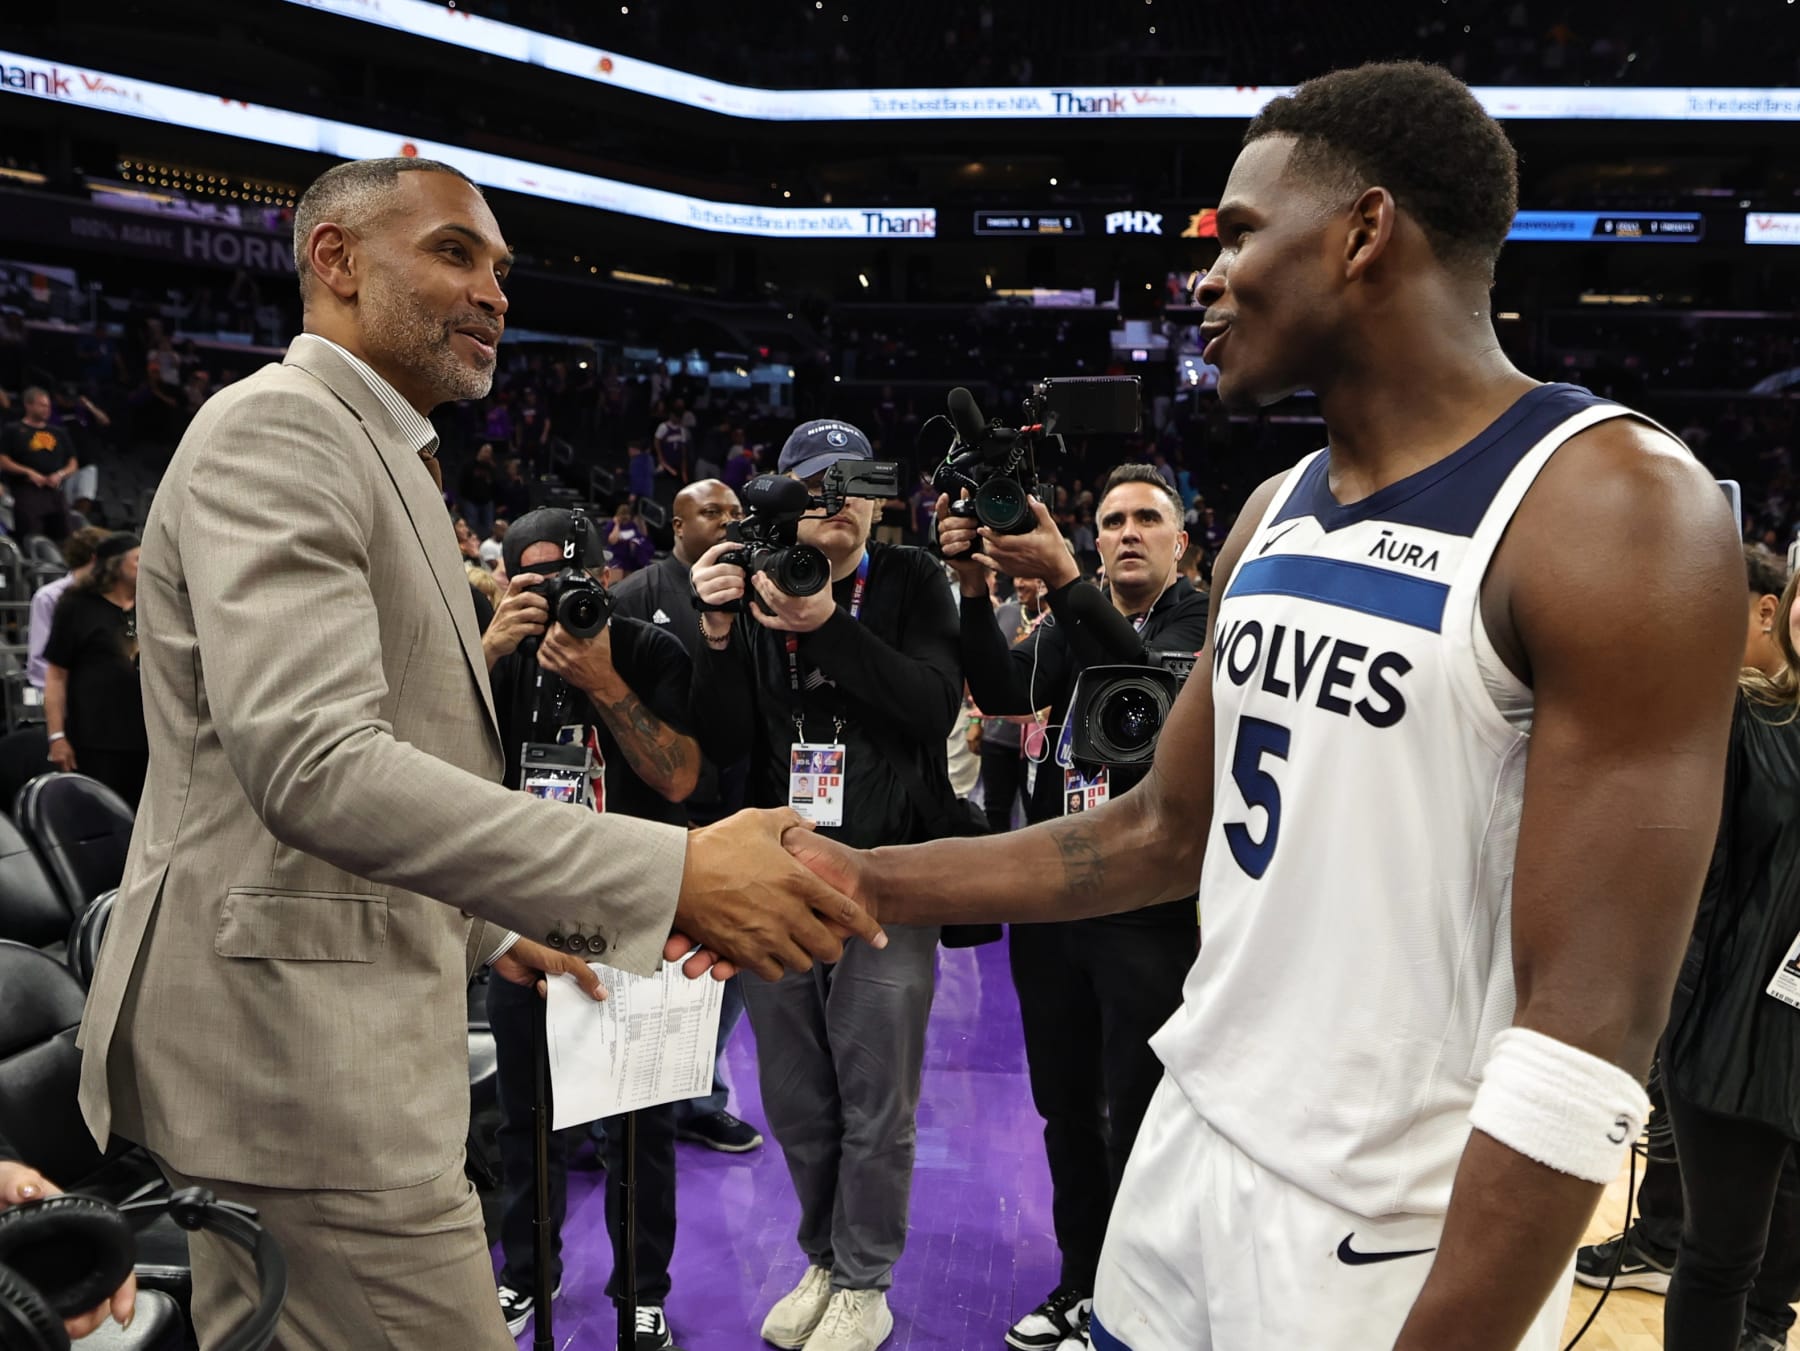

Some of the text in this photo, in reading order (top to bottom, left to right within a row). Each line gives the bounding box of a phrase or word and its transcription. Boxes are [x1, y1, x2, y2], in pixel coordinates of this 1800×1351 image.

[1051, 92, 1125, 113] Thank
[862, 213, 935, 233] Thank
[1105, 210, 1163, 235] PHX
[1213, 619, 1413, 728] WOLVES
[1223, 714, 1292, 881] 5
